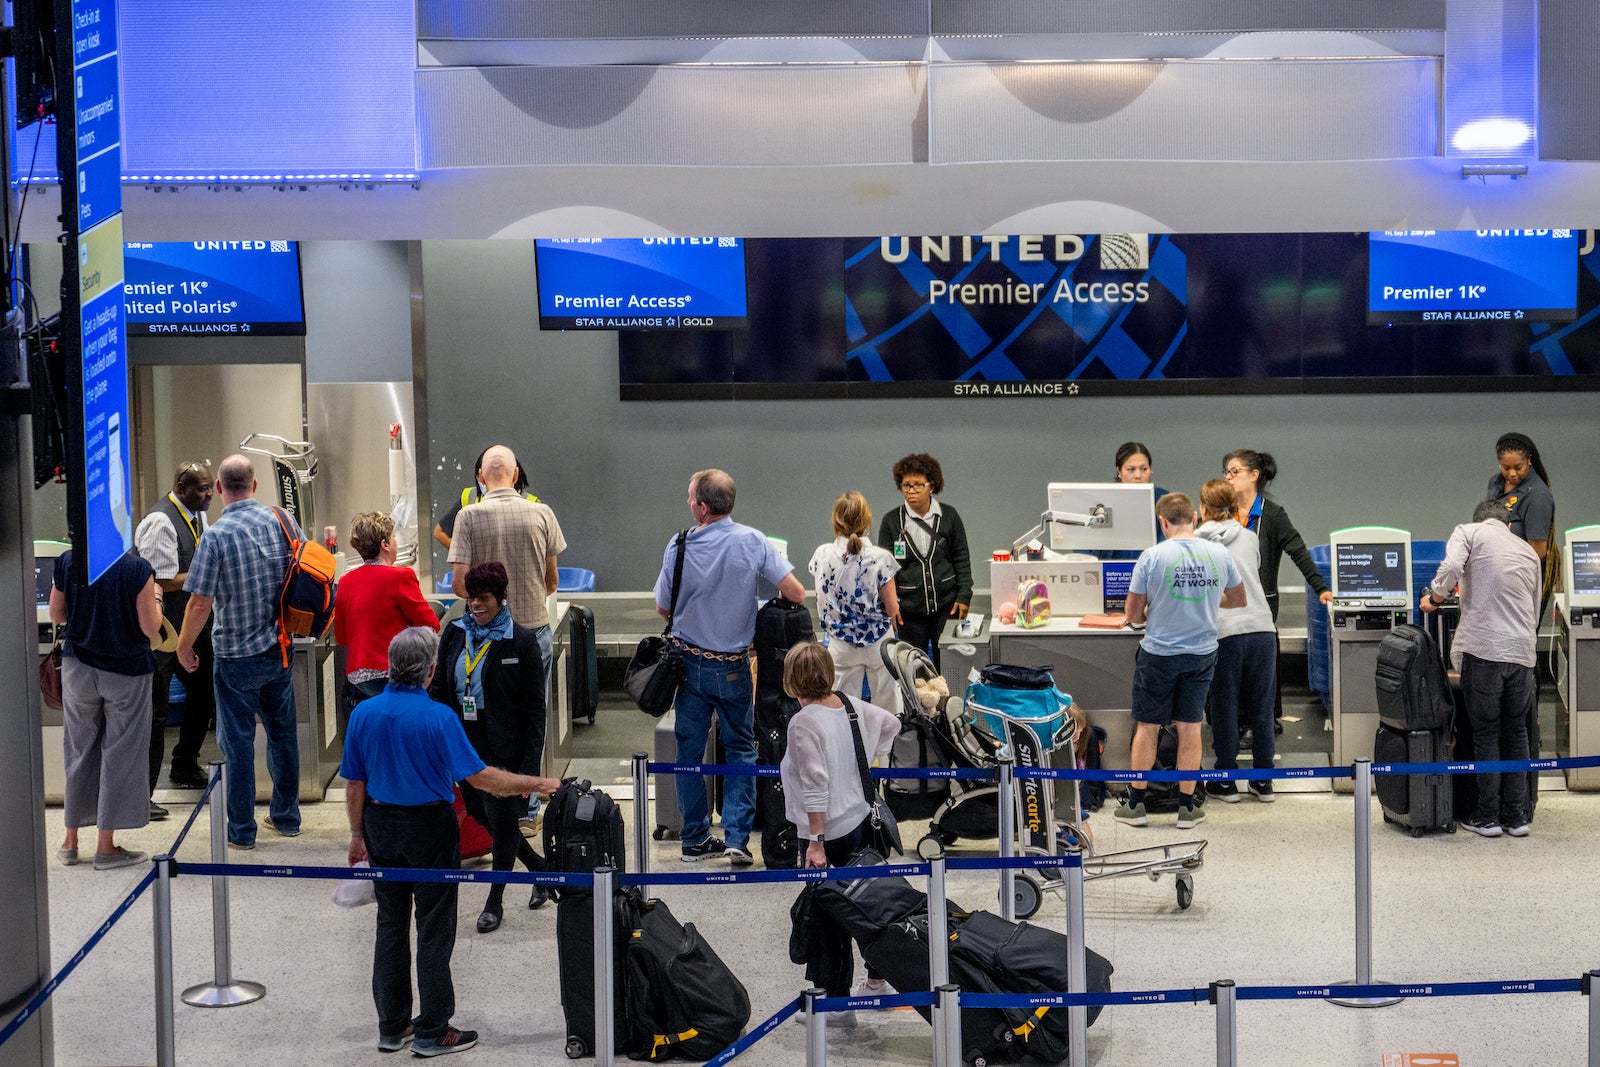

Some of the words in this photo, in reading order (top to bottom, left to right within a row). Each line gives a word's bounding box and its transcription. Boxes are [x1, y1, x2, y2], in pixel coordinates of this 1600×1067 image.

[78, 94, 113, 125] Unaccompanied
[79, 130, 95, 149] minors
[80, 203, 92, 220] Pets
[194, 241, 266, 250] UNITED
[643, 236, 714, 245] UNITED
[881, 235, 1084, 262] UNITED
[83, 270, 100, 292] Security
[124, 282, 174, 294] emier
[930, 278, 1044, 304] Premier
[1053, 279, 1150, 303] Access
[1384, 286, 1453, 300] Premier
[554, 295, 622, 308] Premier
[125, 302, 165, 314] nited
[1423, 312, 1451, 320] STAR
[1454, 310, 1511, 320] ALLIANCE
[575, 318, 604, 326] STAR
[607, 318, 662, 326] ALLIANCE
[682, 318, 713, 326] GOLD
[149, 324, 178, 333] STAR
[181, 324, 237, 332] ALLIANCE
[954, 384, 989, 395] STAR
[993, 384, 1062, 394] ALLIANCE
[1019, 575, 1080, 583] UNITED
[1173, 580, 1186, 588] AT
[1188, 579, 1218, 588] WORK
[1019, 744, 1041, 833] smrtecarte
